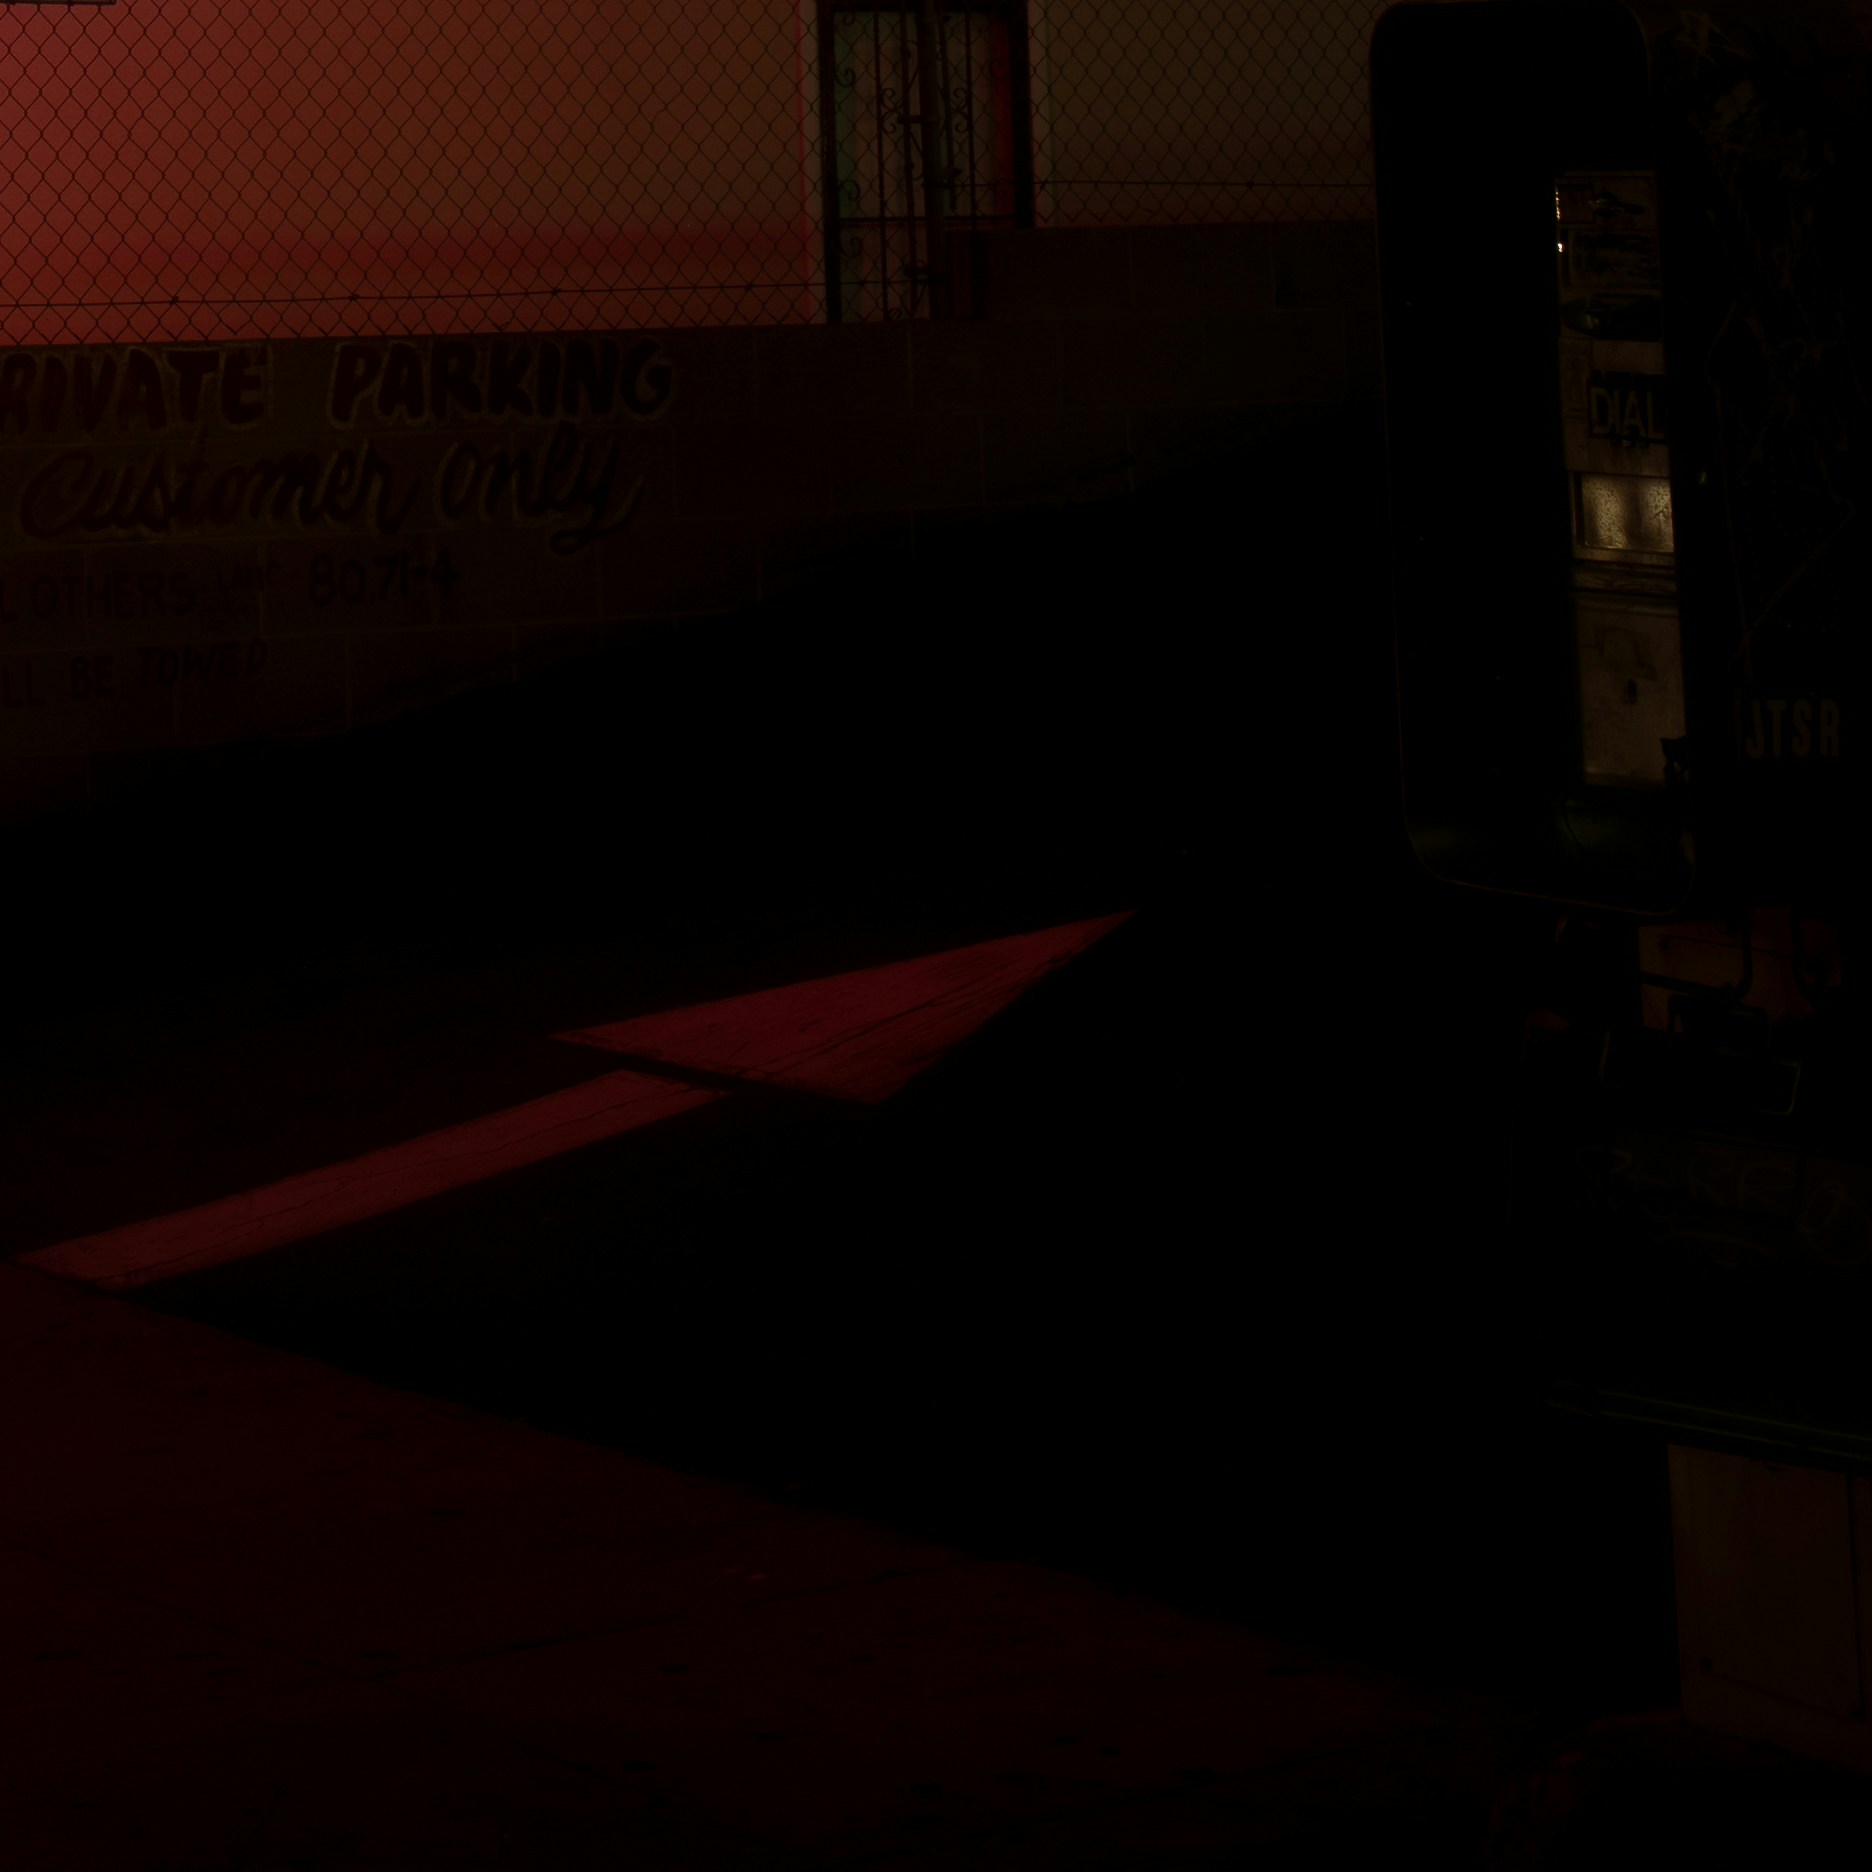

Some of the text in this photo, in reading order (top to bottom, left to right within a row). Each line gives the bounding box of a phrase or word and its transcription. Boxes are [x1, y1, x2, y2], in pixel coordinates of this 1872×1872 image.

[331, 338, 673, 425] PARKING
[1590, 386, 1665, 440] DIAL
[21, 430, 422, 538] Customer
[29, 571, 196, 621] OTHERS
[71, 653, 114, 702] BE
[138, 639, 268, 688] TOWED
